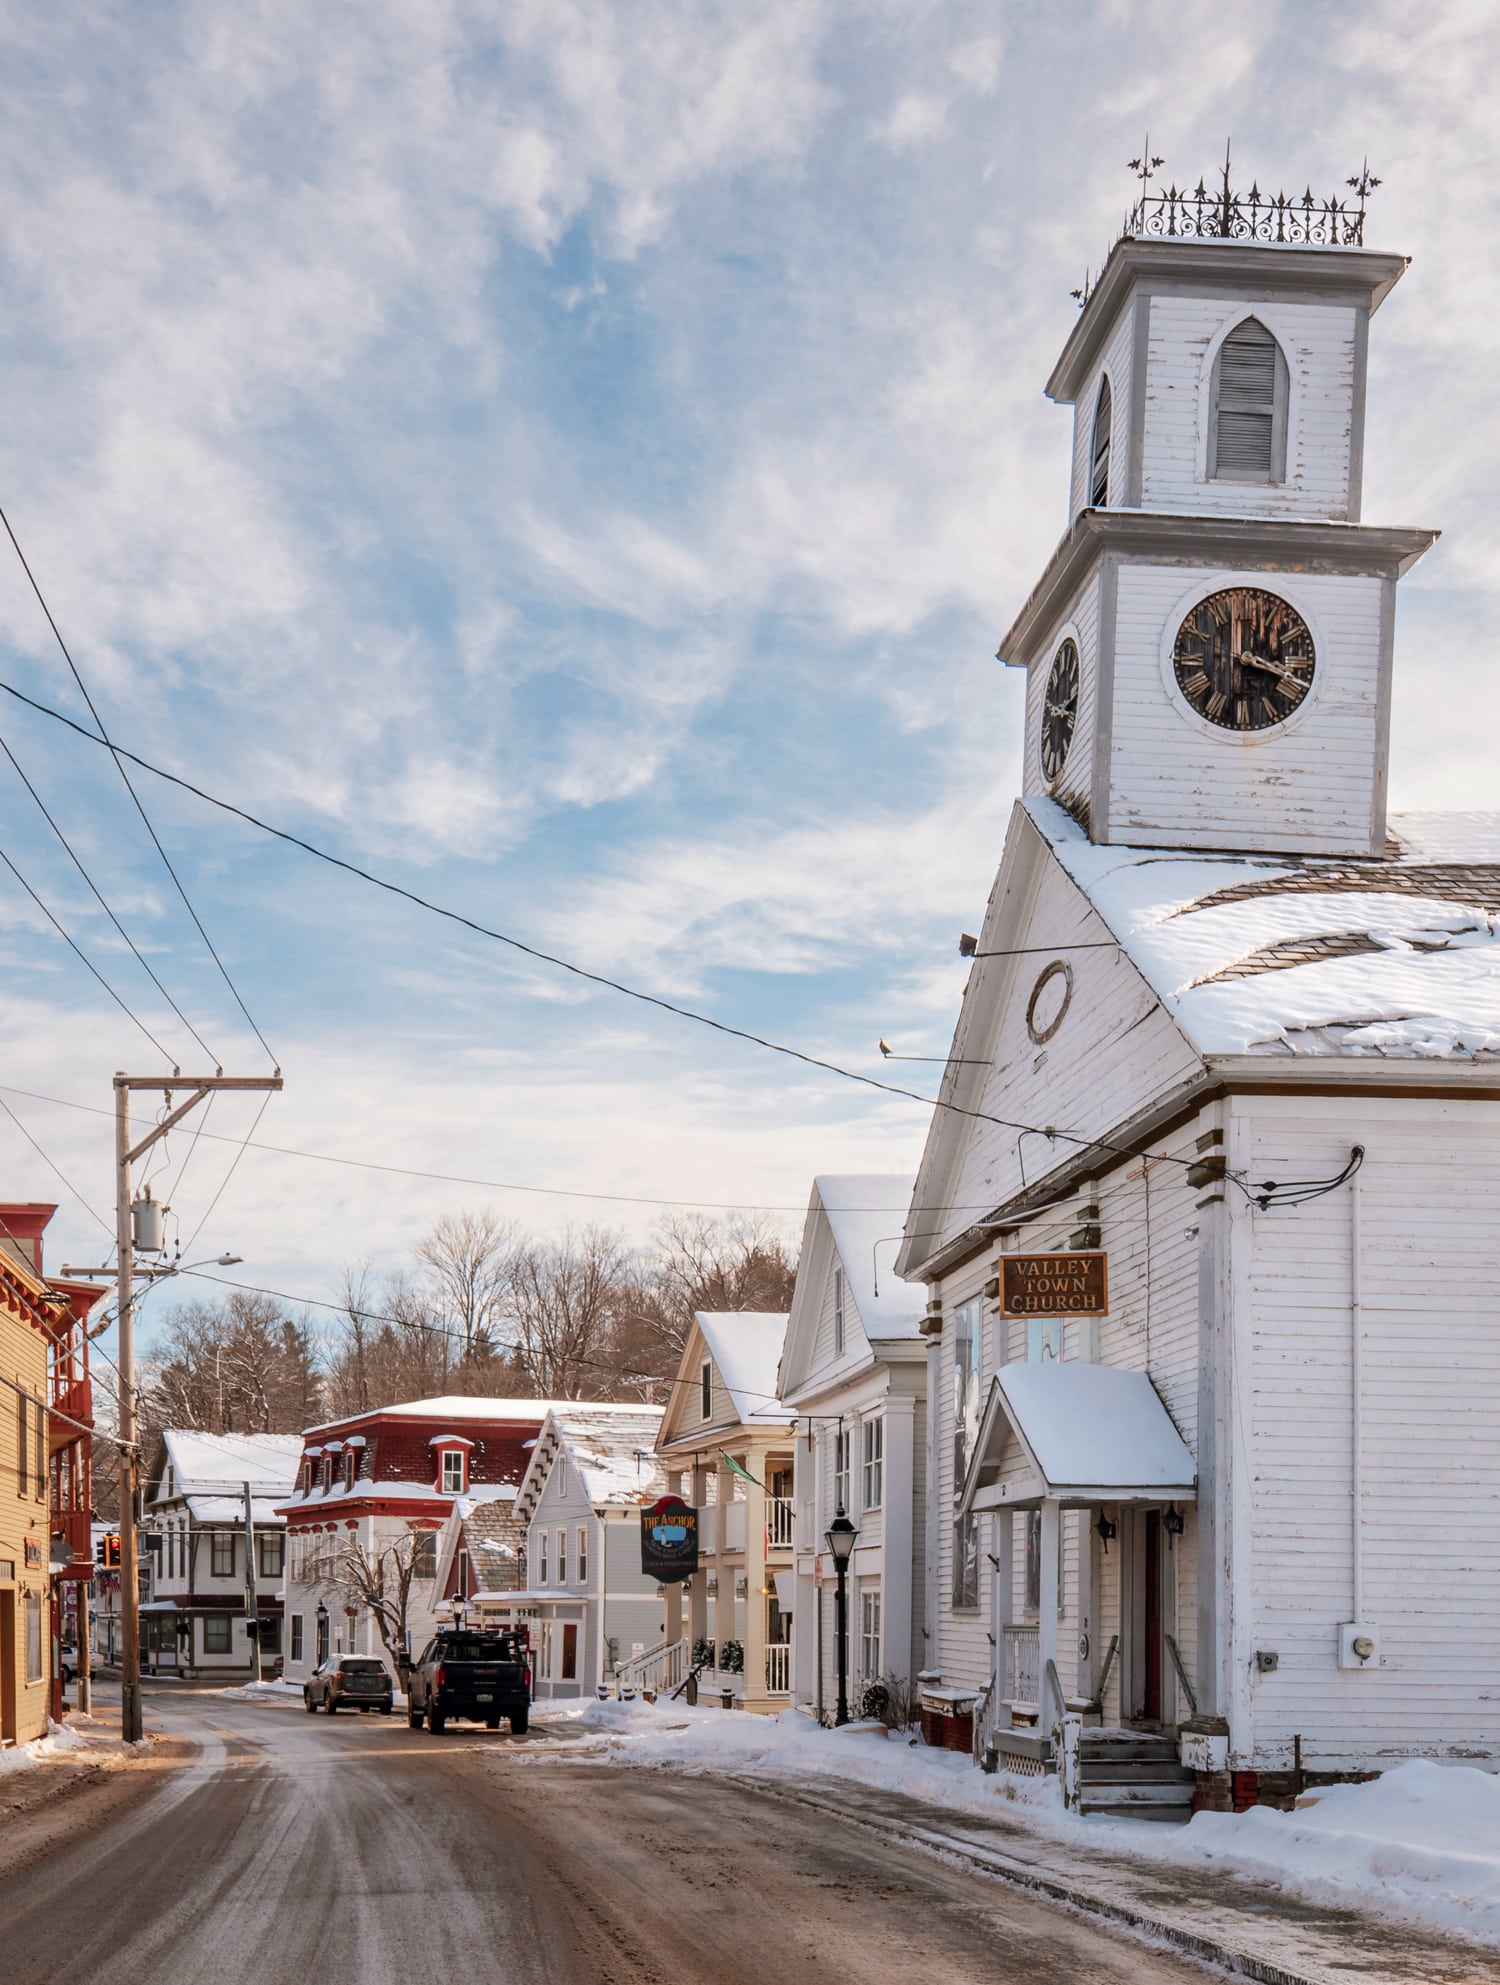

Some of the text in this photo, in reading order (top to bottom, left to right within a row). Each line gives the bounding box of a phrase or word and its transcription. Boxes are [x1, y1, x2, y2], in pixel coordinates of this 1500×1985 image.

[1016, 1260, 1093, 1276] VALLEY
[1023, 1277, 1086, 1293] TOWN
[1011, 1294, 1097, 1311] CHURCH
[643, 1514, 696, 1531] THE ANCHOR
